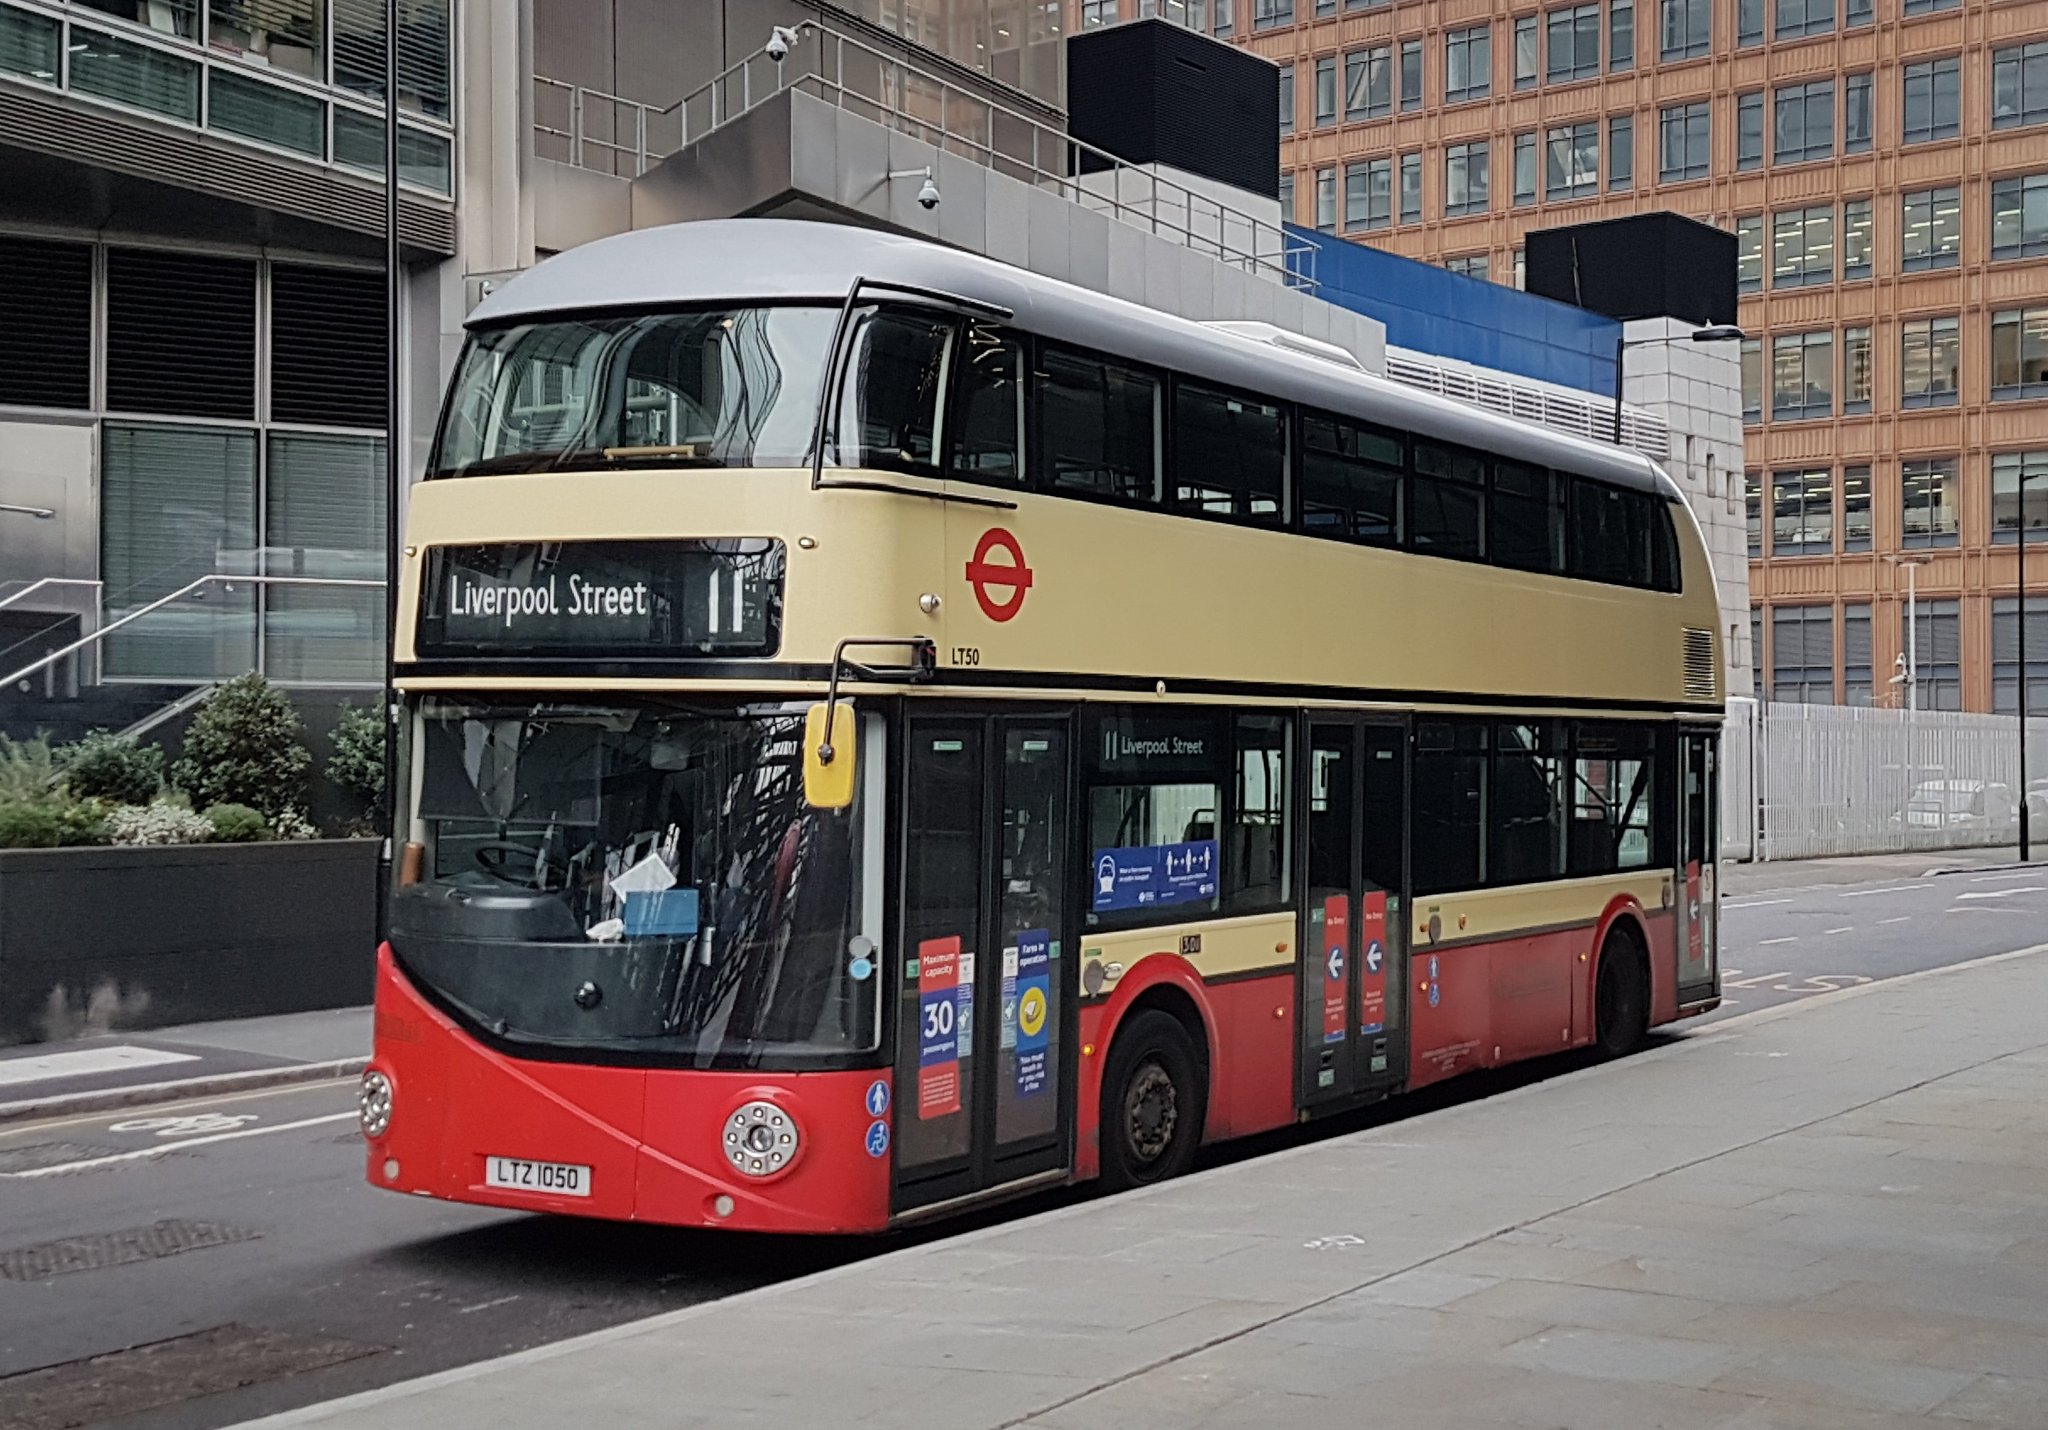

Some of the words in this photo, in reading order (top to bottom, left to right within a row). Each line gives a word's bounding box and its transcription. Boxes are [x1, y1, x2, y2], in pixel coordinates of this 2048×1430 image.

[450, 574, 560, 628] Liverpool
[568, 573, 648, 616] Street
[708, 566, 744, 634] 11
[951, 647, 980, 666] LT50
[1104, 730, 1118, 761] 11
[1121, 735, 1170, 759] Liverpool
[1172, 736, 1204, 755] Street
[923, 952, 956, 965] Maximum
[924, 965, 954, 979] capacity
[923, 1000, 954, 1039] 30
[497, 1159, 533, 1184] LTZ
[537, 1164, 579, 1190] 1050
